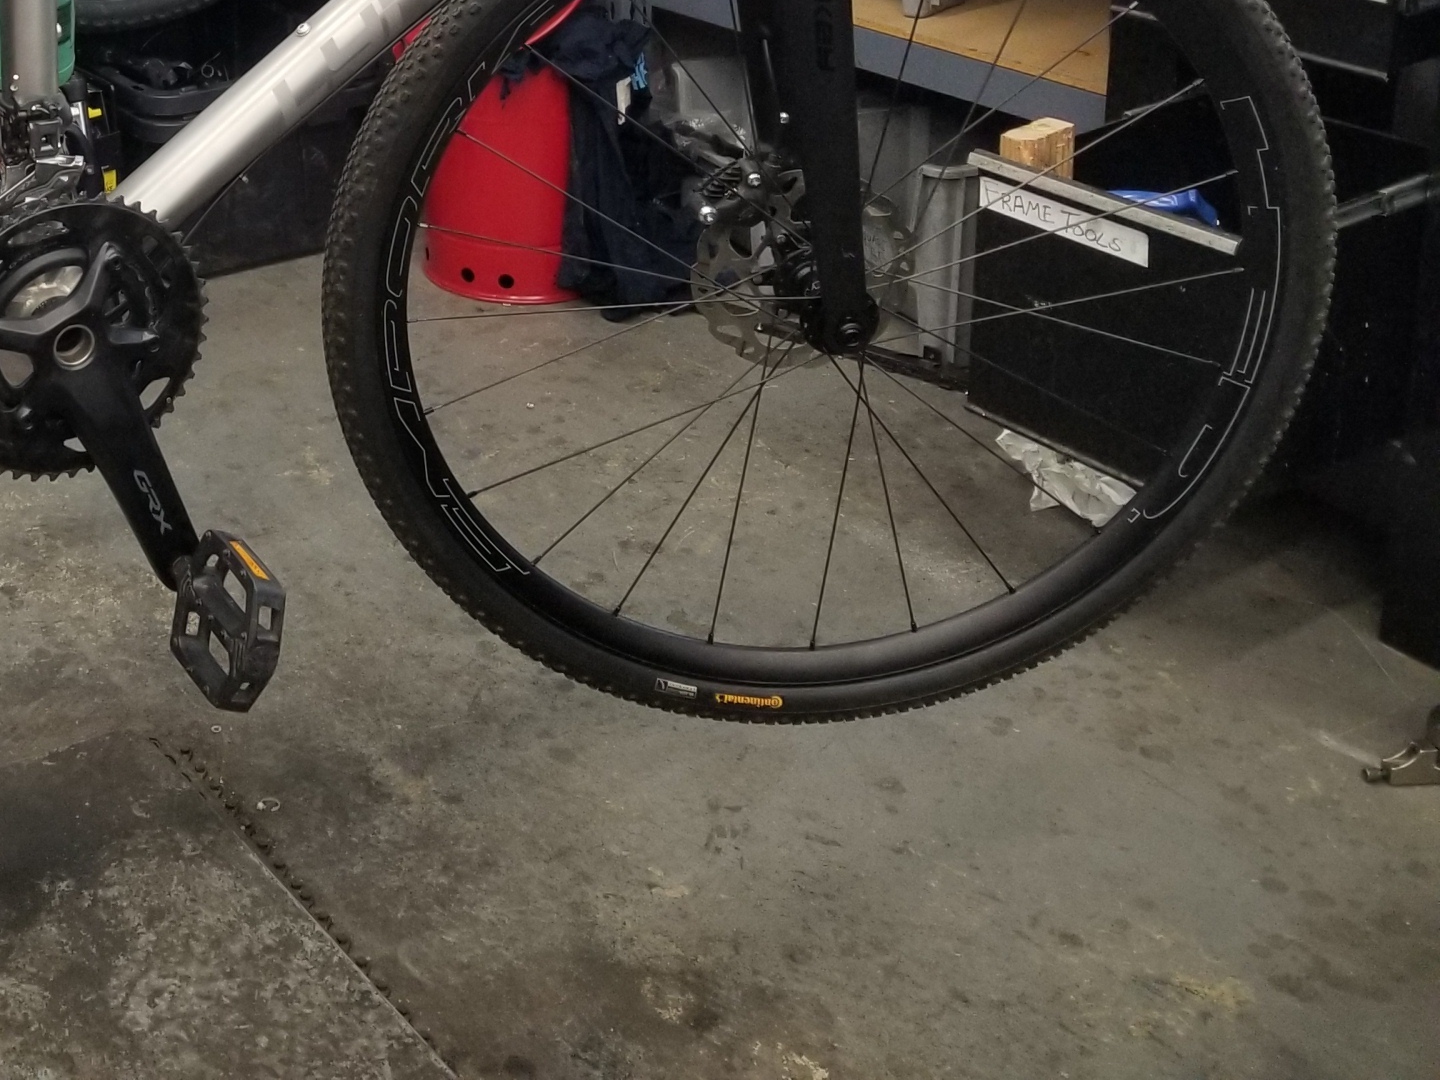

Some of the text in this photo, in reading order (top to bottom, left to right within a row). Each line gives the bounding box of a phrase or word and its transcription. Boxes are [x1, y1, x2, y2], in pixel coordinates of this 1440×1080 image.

[982, 180, 1122, 253] FRAME TOOLS
[133, 469, 173, 536] GRX
[723, 694, 783, 709] Continental
